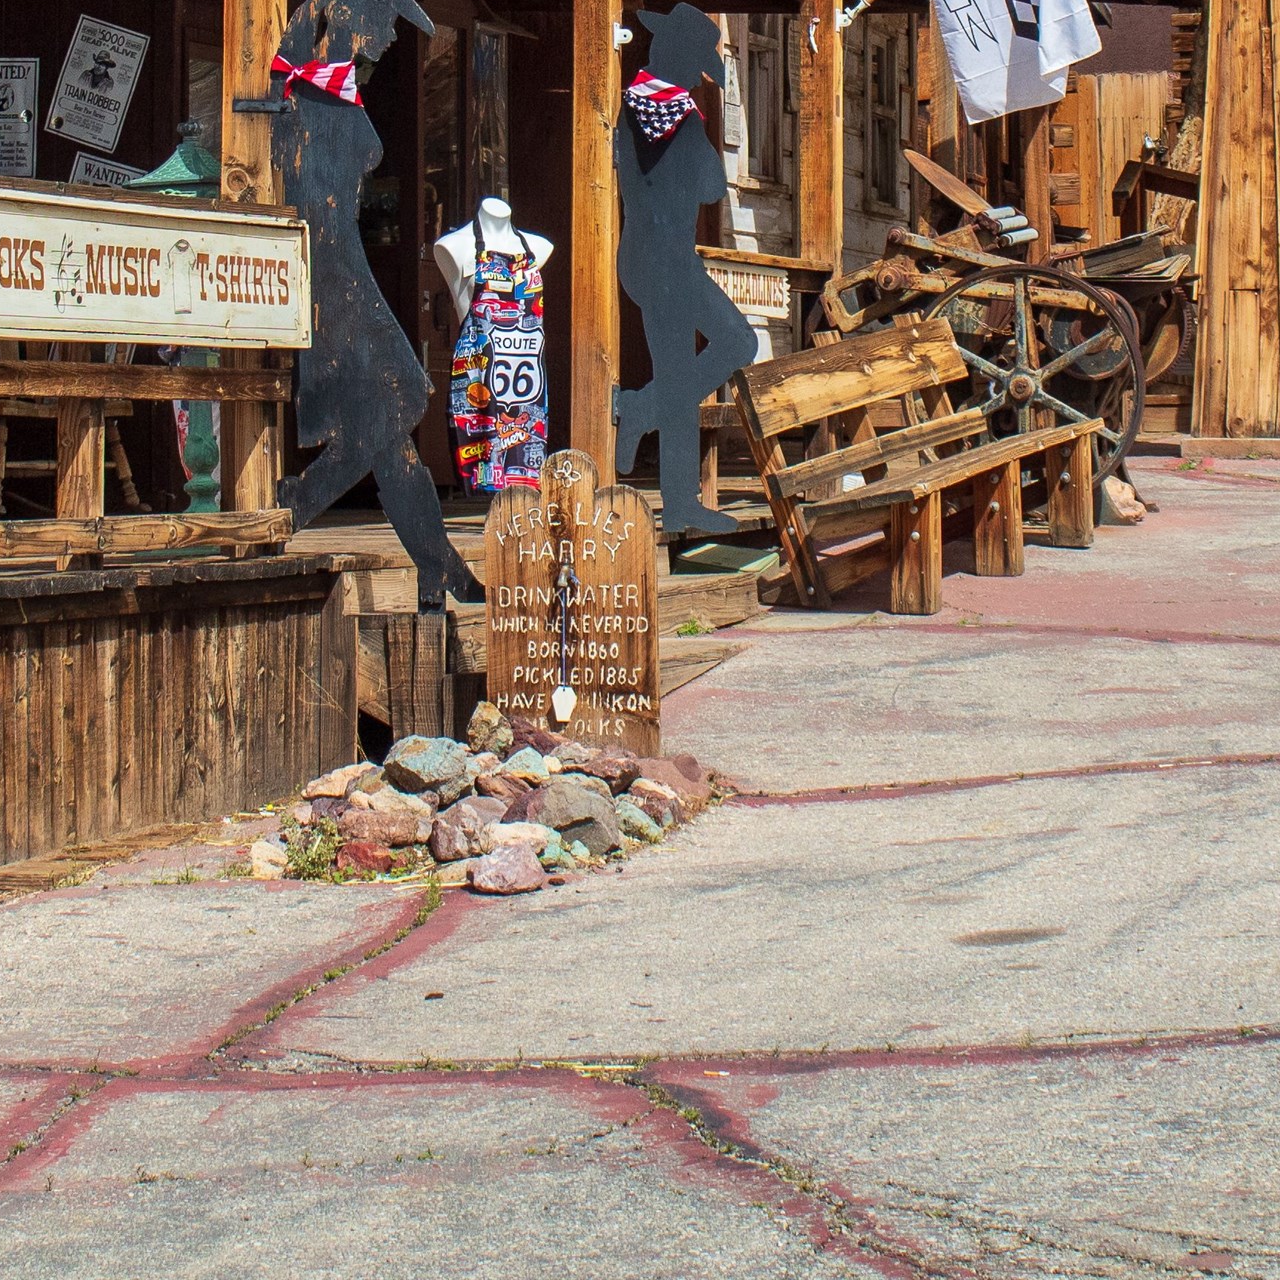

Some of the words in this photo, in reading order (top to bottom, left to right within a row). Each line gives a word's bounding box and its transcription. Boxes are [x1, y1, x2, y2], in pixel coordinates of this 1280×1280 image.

[110, 45, 138, 60] ALIVE
[63, 82, 88, 101] TRAIN
[88, 91, 121, 114] ROBBER
[86, 243, 161, 298] MUSIC
[481, 272, 507, 281] MOTEL
[731, 270, 784, 308] HEADLINES
[494, 336, 537, 350] ROUTE
[494, 359, 535, 398] 66
[527, 455, 543, 467] 66
[496, 502, 562, 547] HERE
[575, 501, 635, 541] LIES
[519, 539, 621, 564] HARRY
[491, 616, 539, 633] WHICH
[545, 616, 564, 633] HE
[569, 614, 623, 634] NEVER
[626, 616, 649, 633] DO
[527, 639, 576, 659] BORN
[579, 639, 620, 660] 1860
[513, 665, 594, 686] PICKLED
[600, 664, 642, 686] 1885
[496, 691, 546, 710] HAVE
